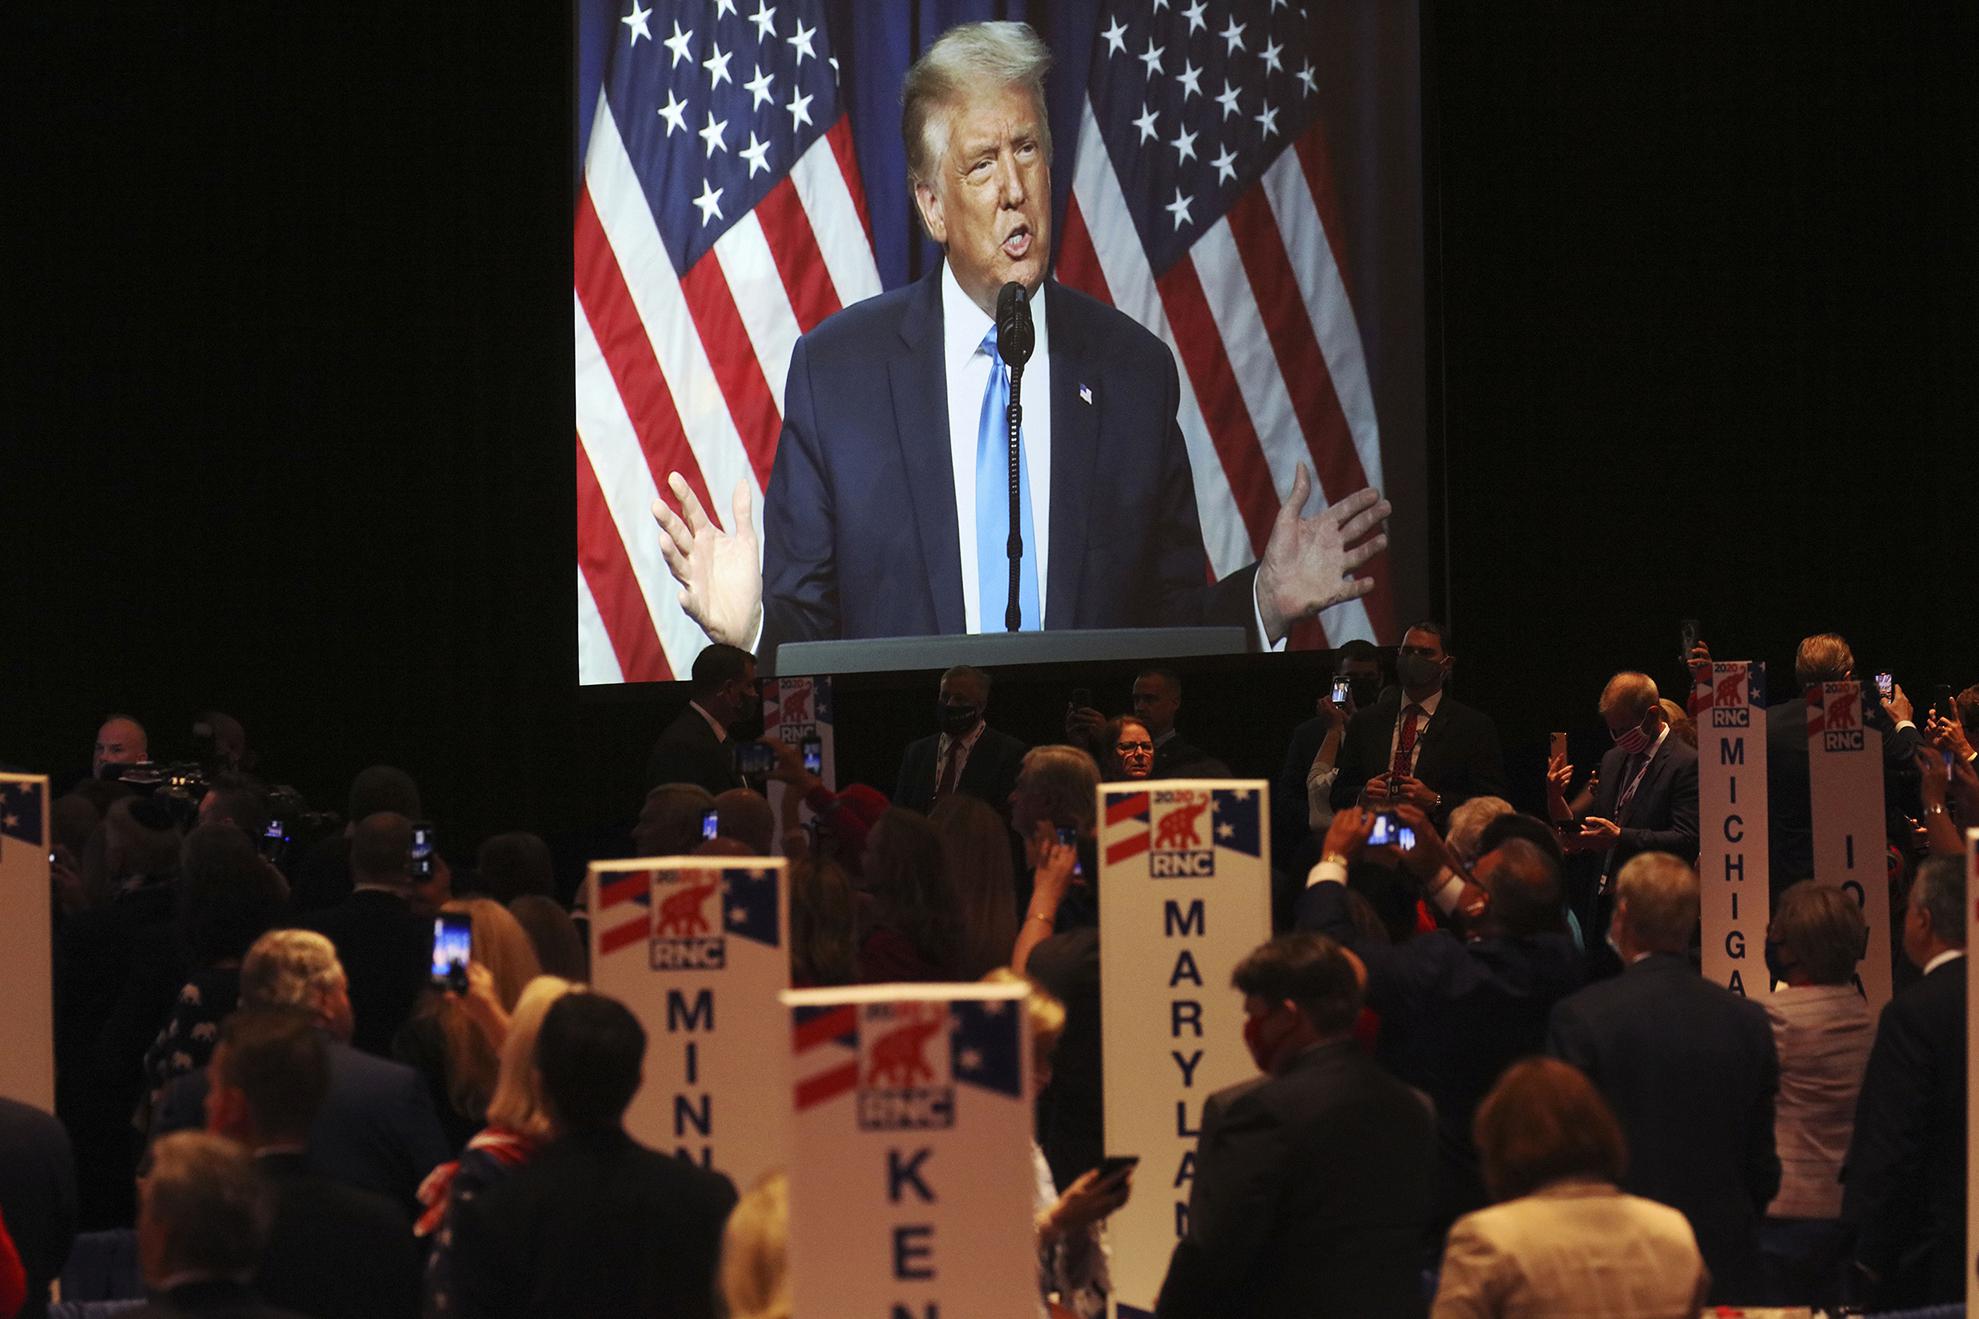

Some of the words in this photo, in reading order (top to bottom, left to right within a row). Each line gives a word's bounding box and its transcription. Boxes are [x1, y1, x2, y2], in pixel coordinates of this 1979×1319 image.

[1714, 664, 1738, 673] 2020
[1714, 709, 1748, 725] RNC
[782, 726, 813, 742] RNC
[1826, 734, 1862, 749] RNC
[1154, 790, 1194, 803] 2020
[1153, 853, 1211, 875] RNC
[1720, 737, 1747, 997] MICHIGA
[656, 941, 722, 965] RNC
